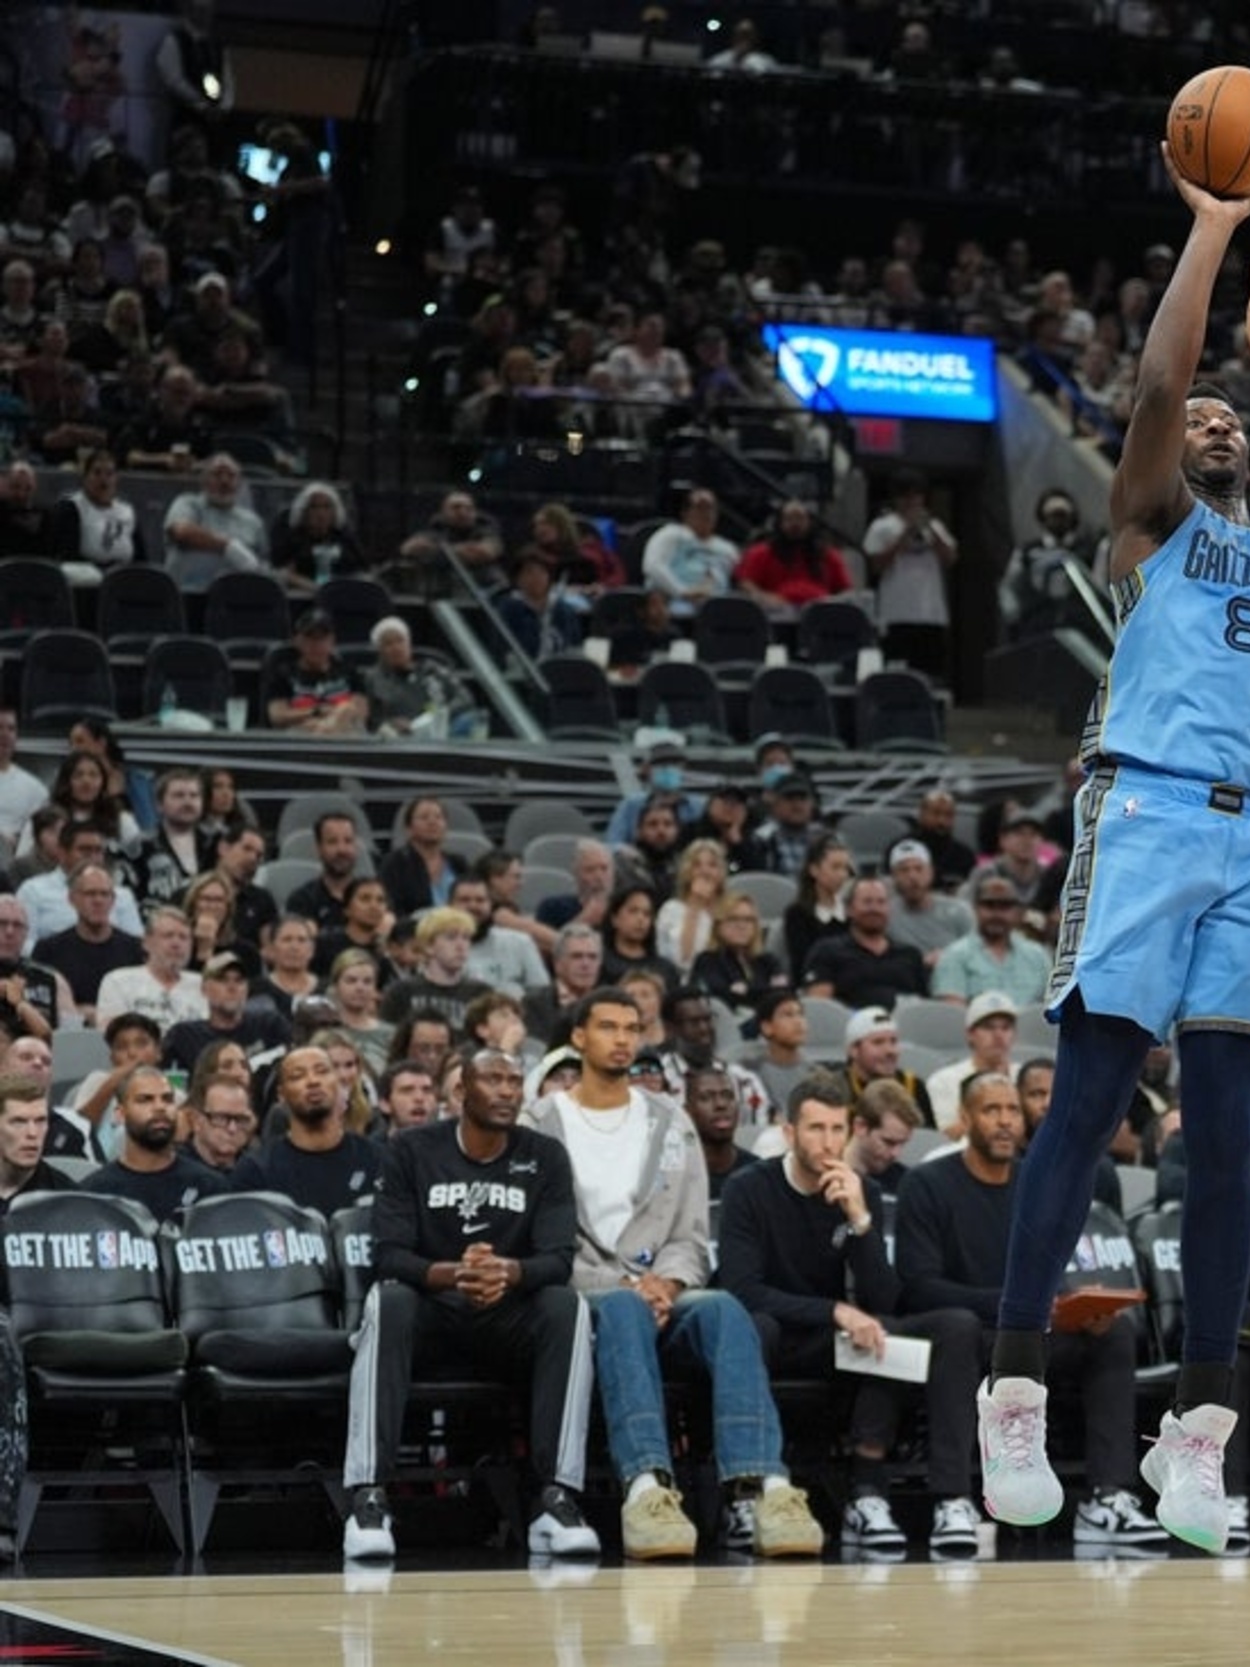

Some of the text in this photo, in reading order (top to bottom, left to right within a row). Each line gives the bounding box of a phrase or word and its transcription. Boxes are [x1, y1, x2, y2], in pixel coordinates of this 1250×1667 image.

[848, 347, 975, 380] FANDUEL
[428, 1181, 526, 1216] SPURS
[4, 1230, 158, 1272] GET THE App
[175, 1227, 328, 1274] GET THE App
[344, 1233, 371, 1267] GE
[1152, 1238, 1181, 1271] GE
